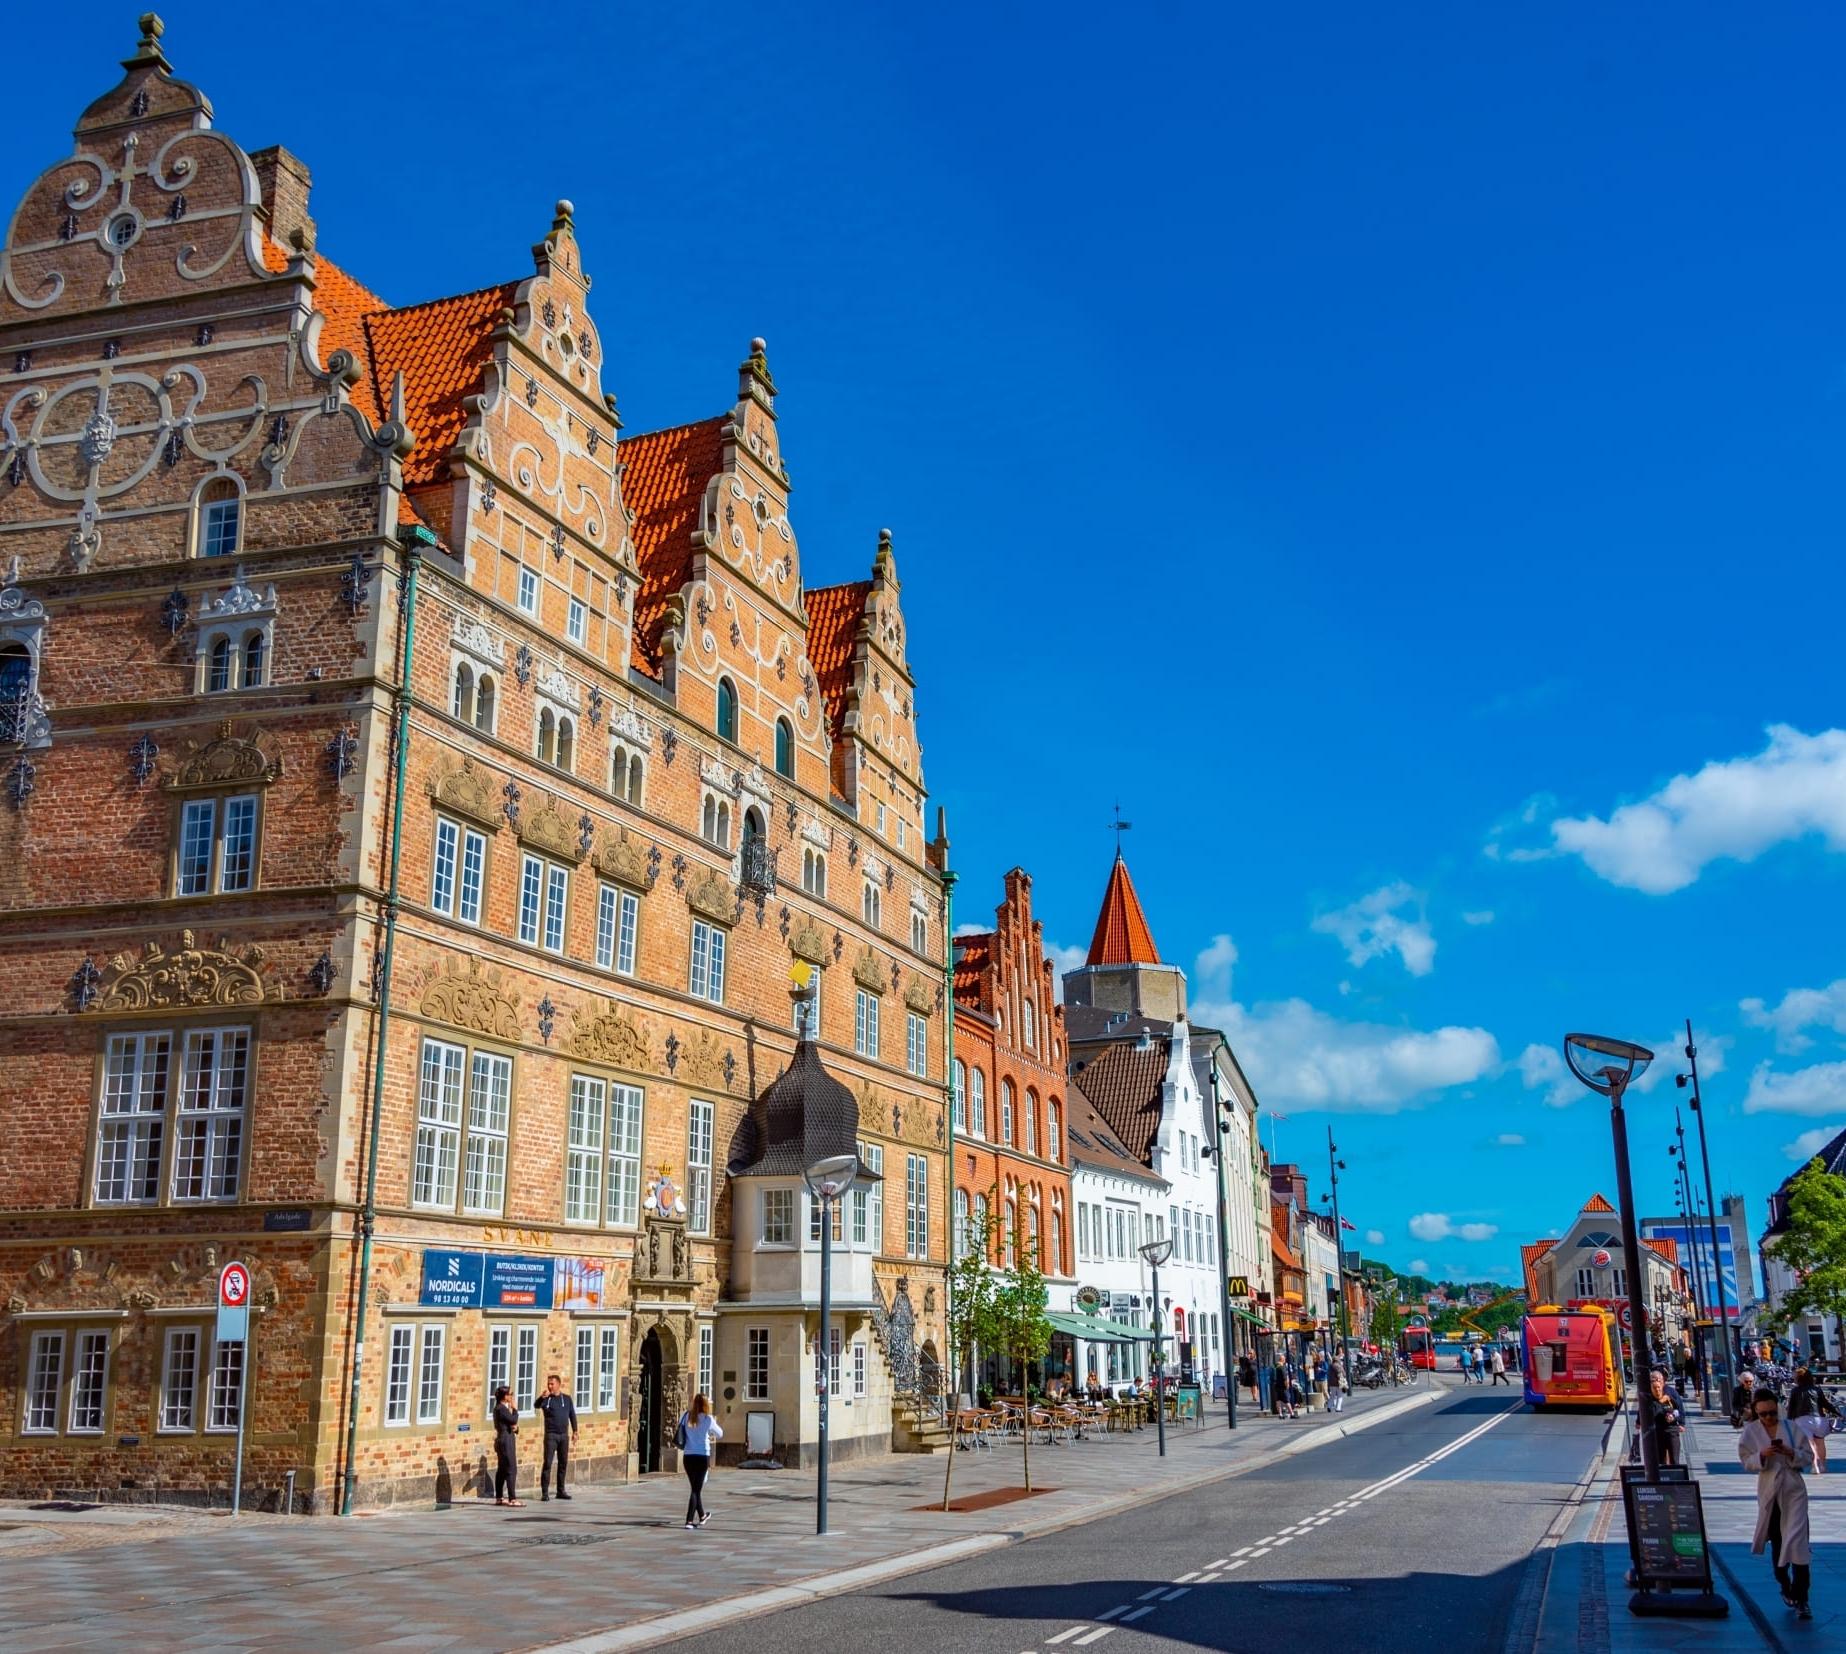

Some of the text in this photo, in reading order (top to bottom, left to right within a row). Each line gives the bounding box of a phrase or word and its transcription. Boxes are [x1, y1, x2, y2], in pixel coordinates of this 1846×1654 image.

[483, 1226, 553, 1247] SVANE
[429, 1279, 476, 1293] NORDICALS
[433, 1294, 442, 1303] 98
[452, 1295, 460, 1304] 40
